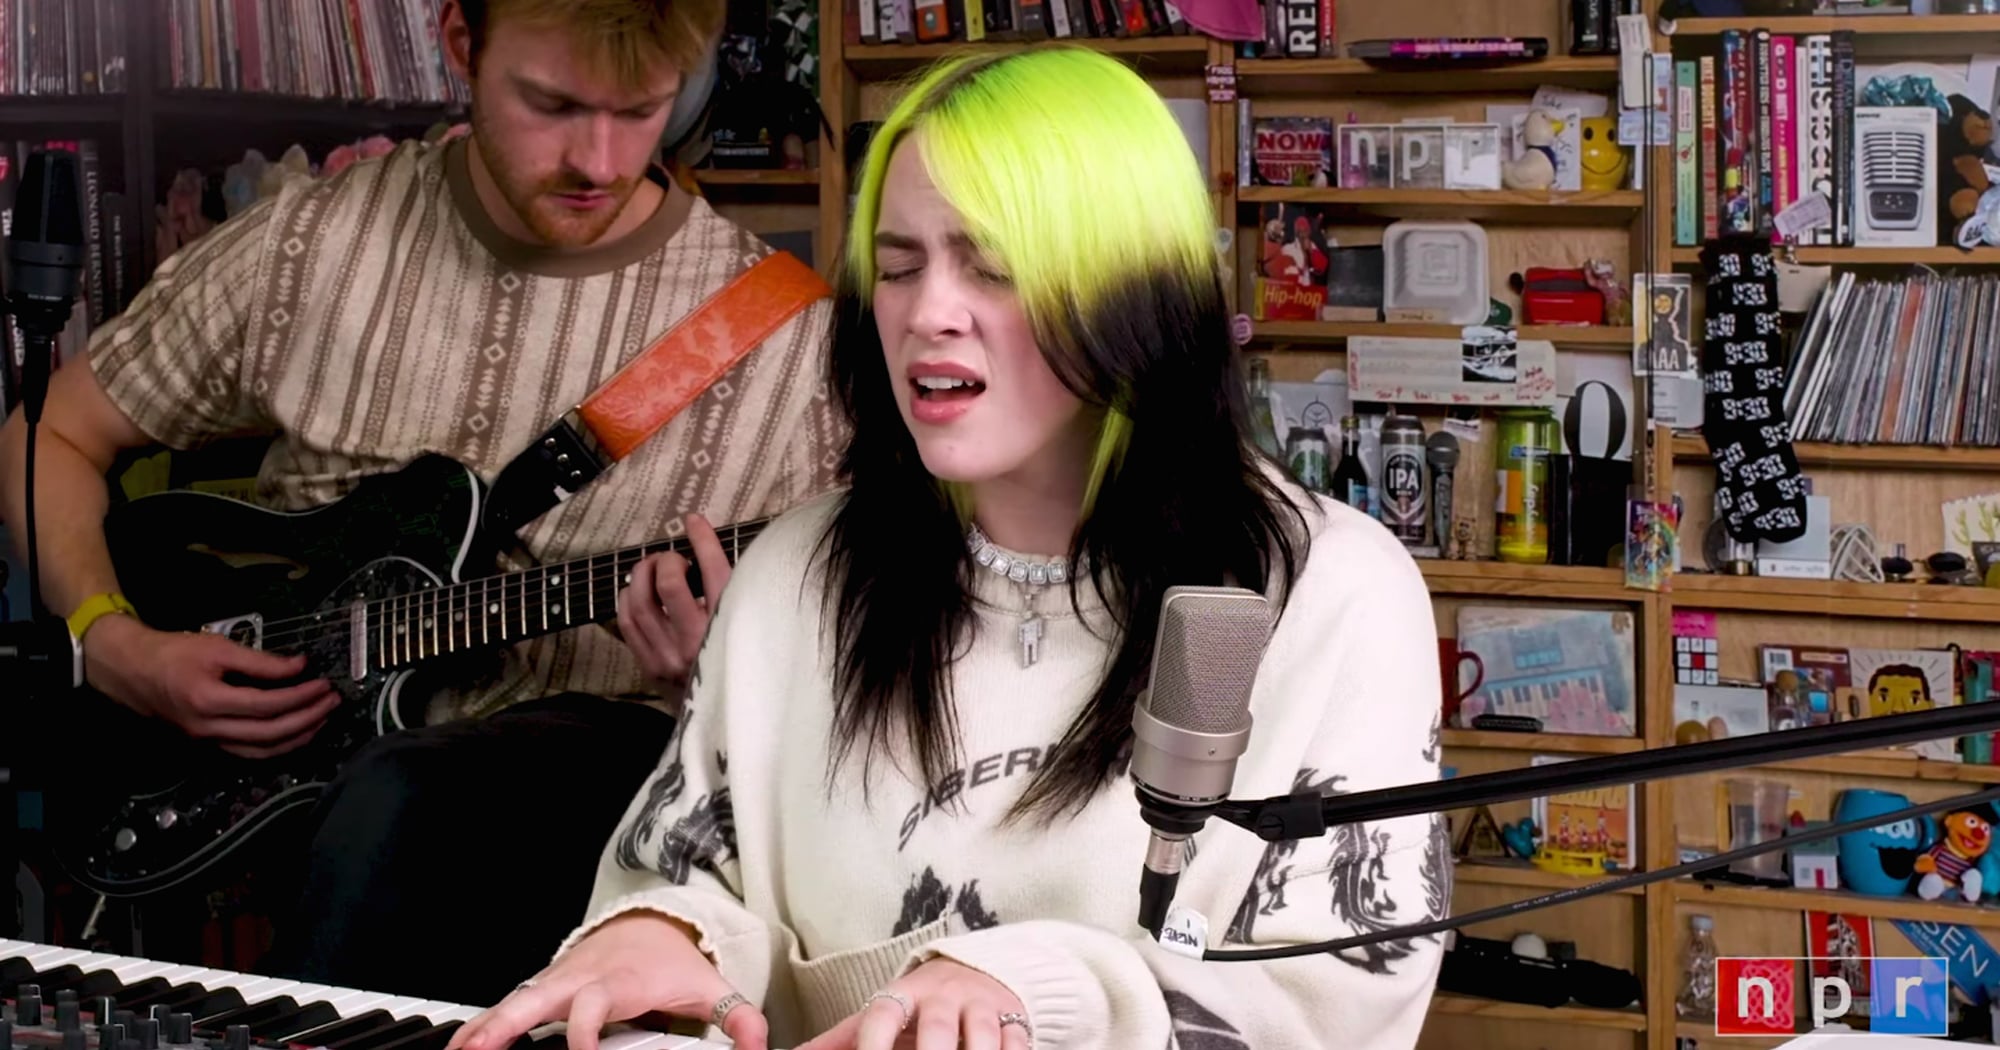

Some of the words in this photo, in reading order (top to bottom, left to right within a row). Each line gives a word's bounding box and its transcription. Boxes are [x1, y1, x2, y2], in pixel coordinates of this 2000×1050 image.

[1289, 0, 1316, 52] RE
[1257, 132, 1319, 150] NOW
[86, 171, 99, 239] LEONARD
[1264, 285, 1323, 309] Hip-hop
[1724, 341, 1769, 365] 9:30
[1722, 396, 1771, 420] 9:30
[1388, 467, 1419, 489] IPA
[1739, 453, 1787, 487] 9:30
